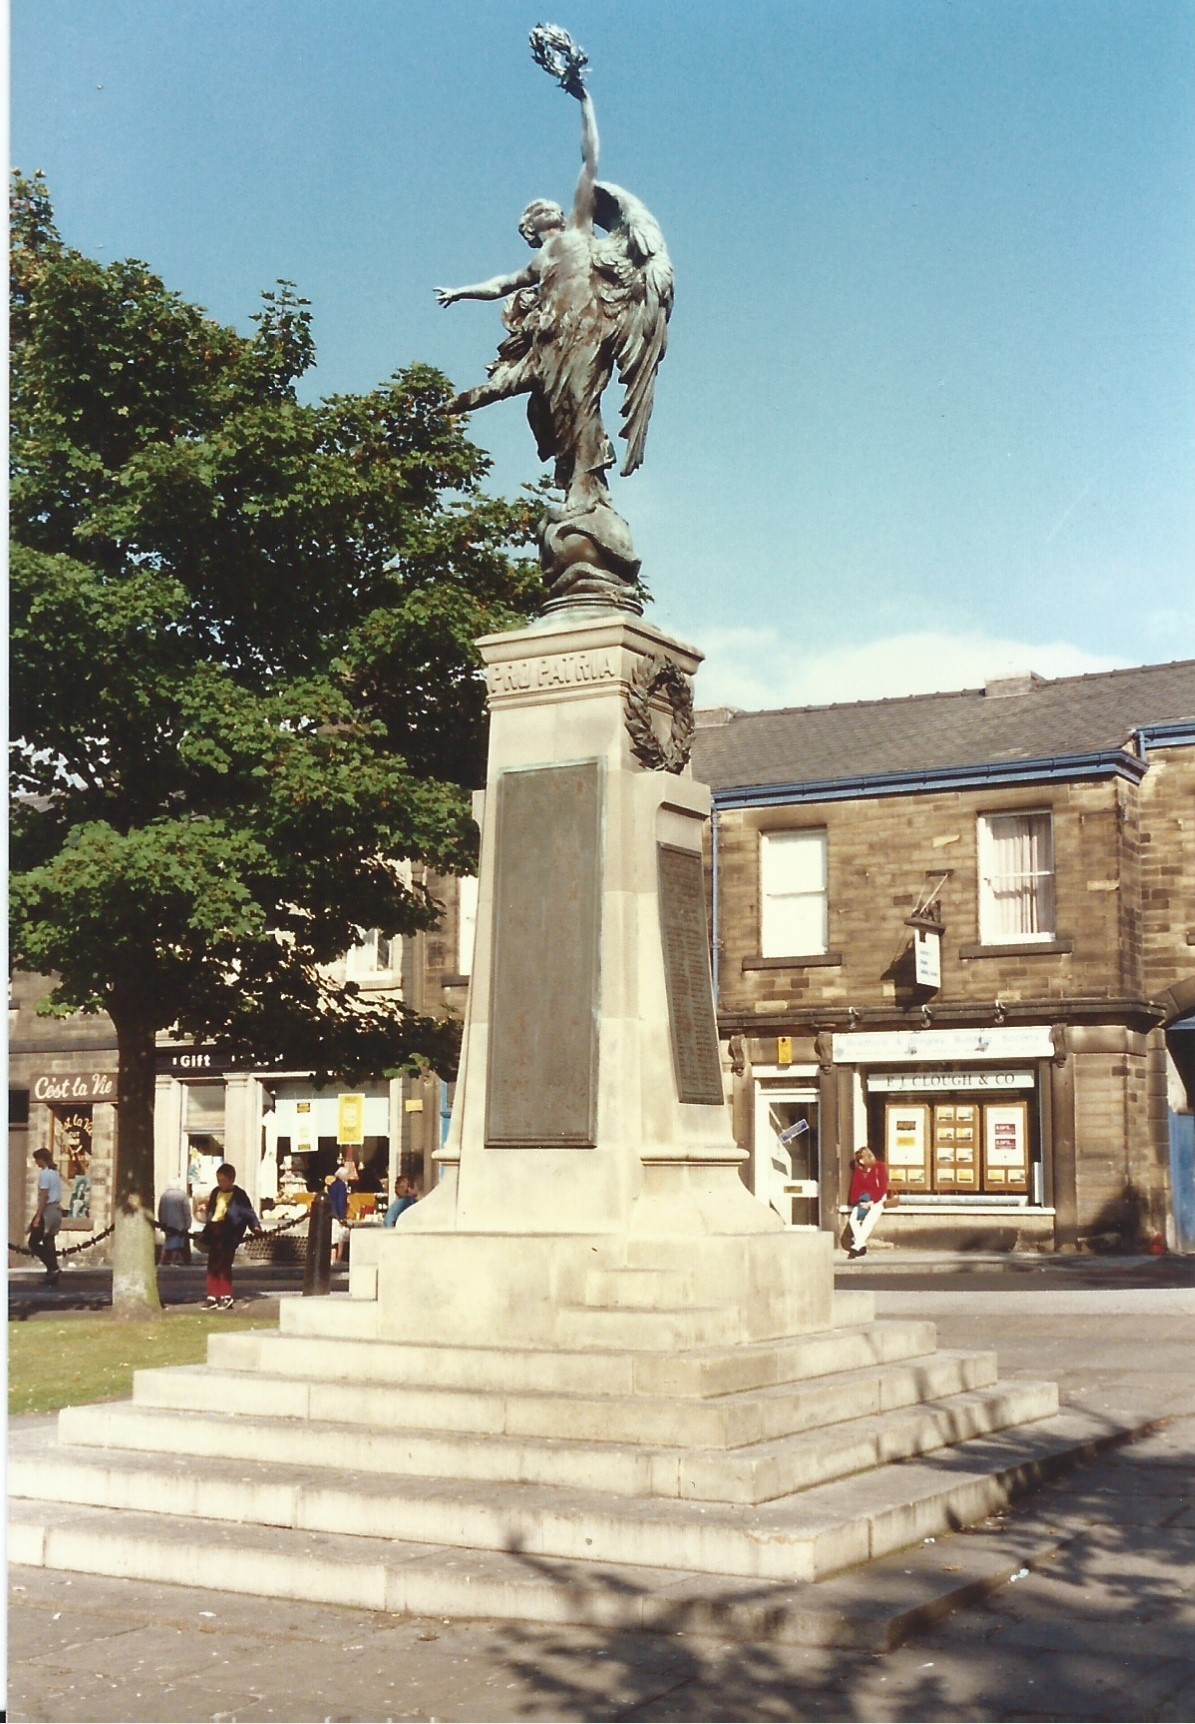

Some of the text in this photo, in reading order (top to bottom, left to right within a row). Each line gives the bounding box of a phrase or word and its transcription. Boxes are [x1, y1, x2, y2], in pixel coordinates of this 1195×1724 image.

[490, 655, 616, 693] PRO PATRIA
[180, 1054, 211, 1068] Gift
[34, 1073, 113, 1100] C'est la Vie
[911, 1074, 972, 1087] CLOUGH
[978, 1073, 988, 1086] &
